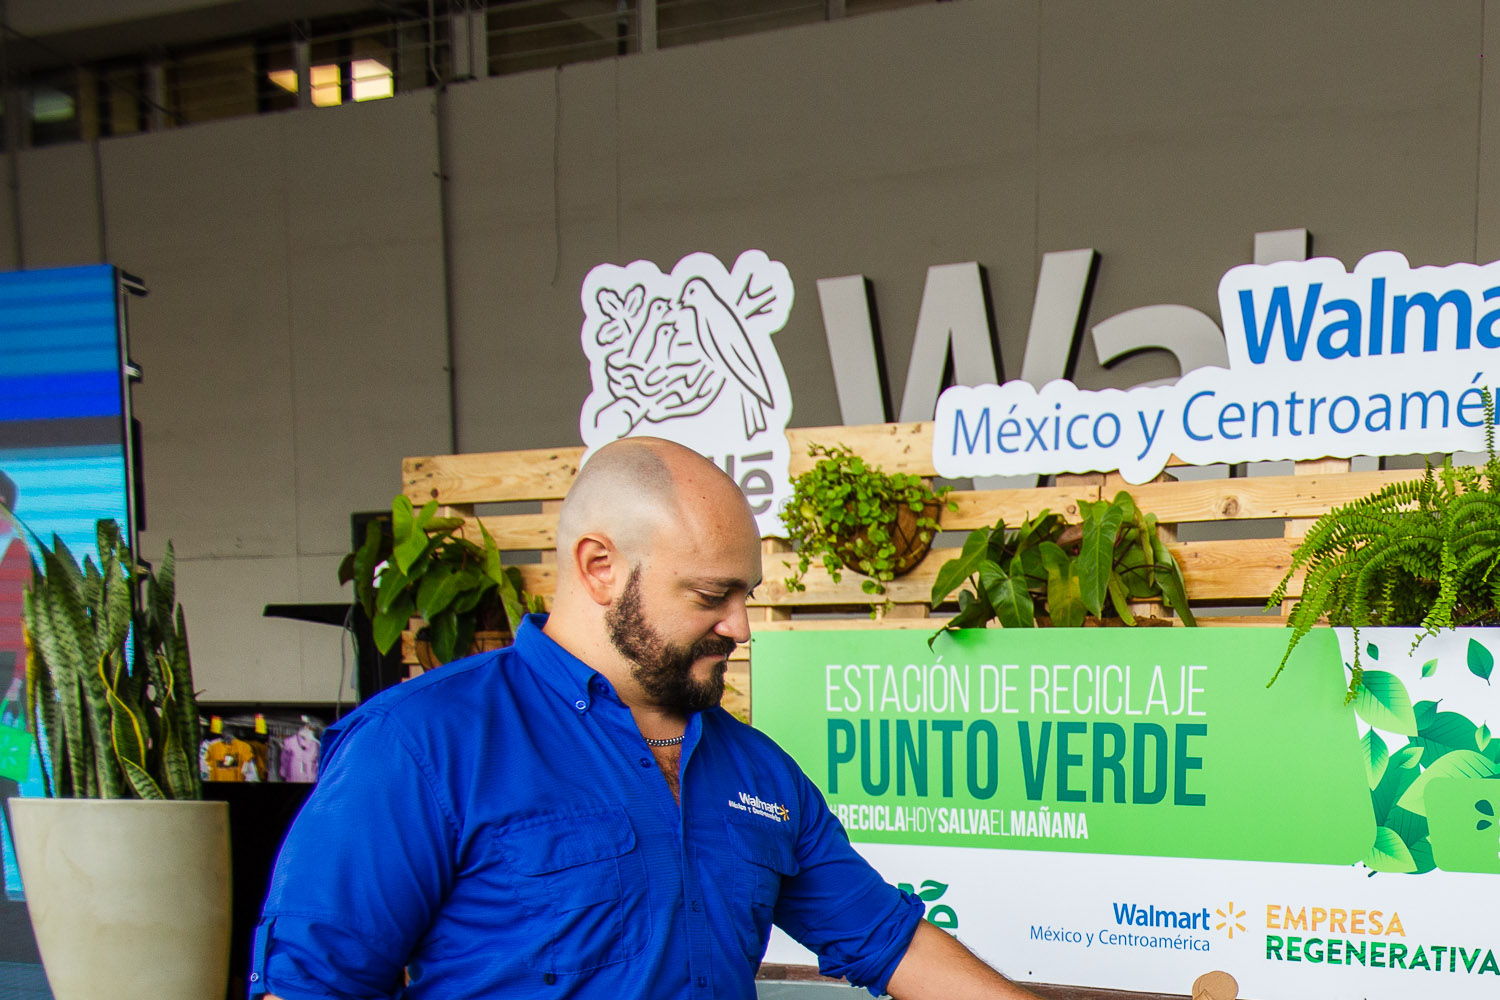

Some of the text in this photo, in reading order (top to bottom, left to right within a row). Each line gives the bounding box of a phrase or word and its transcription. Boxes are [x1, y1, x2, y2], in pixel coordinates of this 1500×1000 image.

[951, 402, 1121, 456] México
[1139, 410, 1166, 460] y
[825, 657, 1208, 716] ESTACIÓN DE RECICLAJE
[826, 718, 1208, 806] PUNTO VERDE
[739, 792, 780, 815] Walmart
[1113, 903, 1211, 932] Walmart
[1266, 904, 1407, 938] EMPRESA
[1030, 925, 1211, 953] México y Centroamérica
